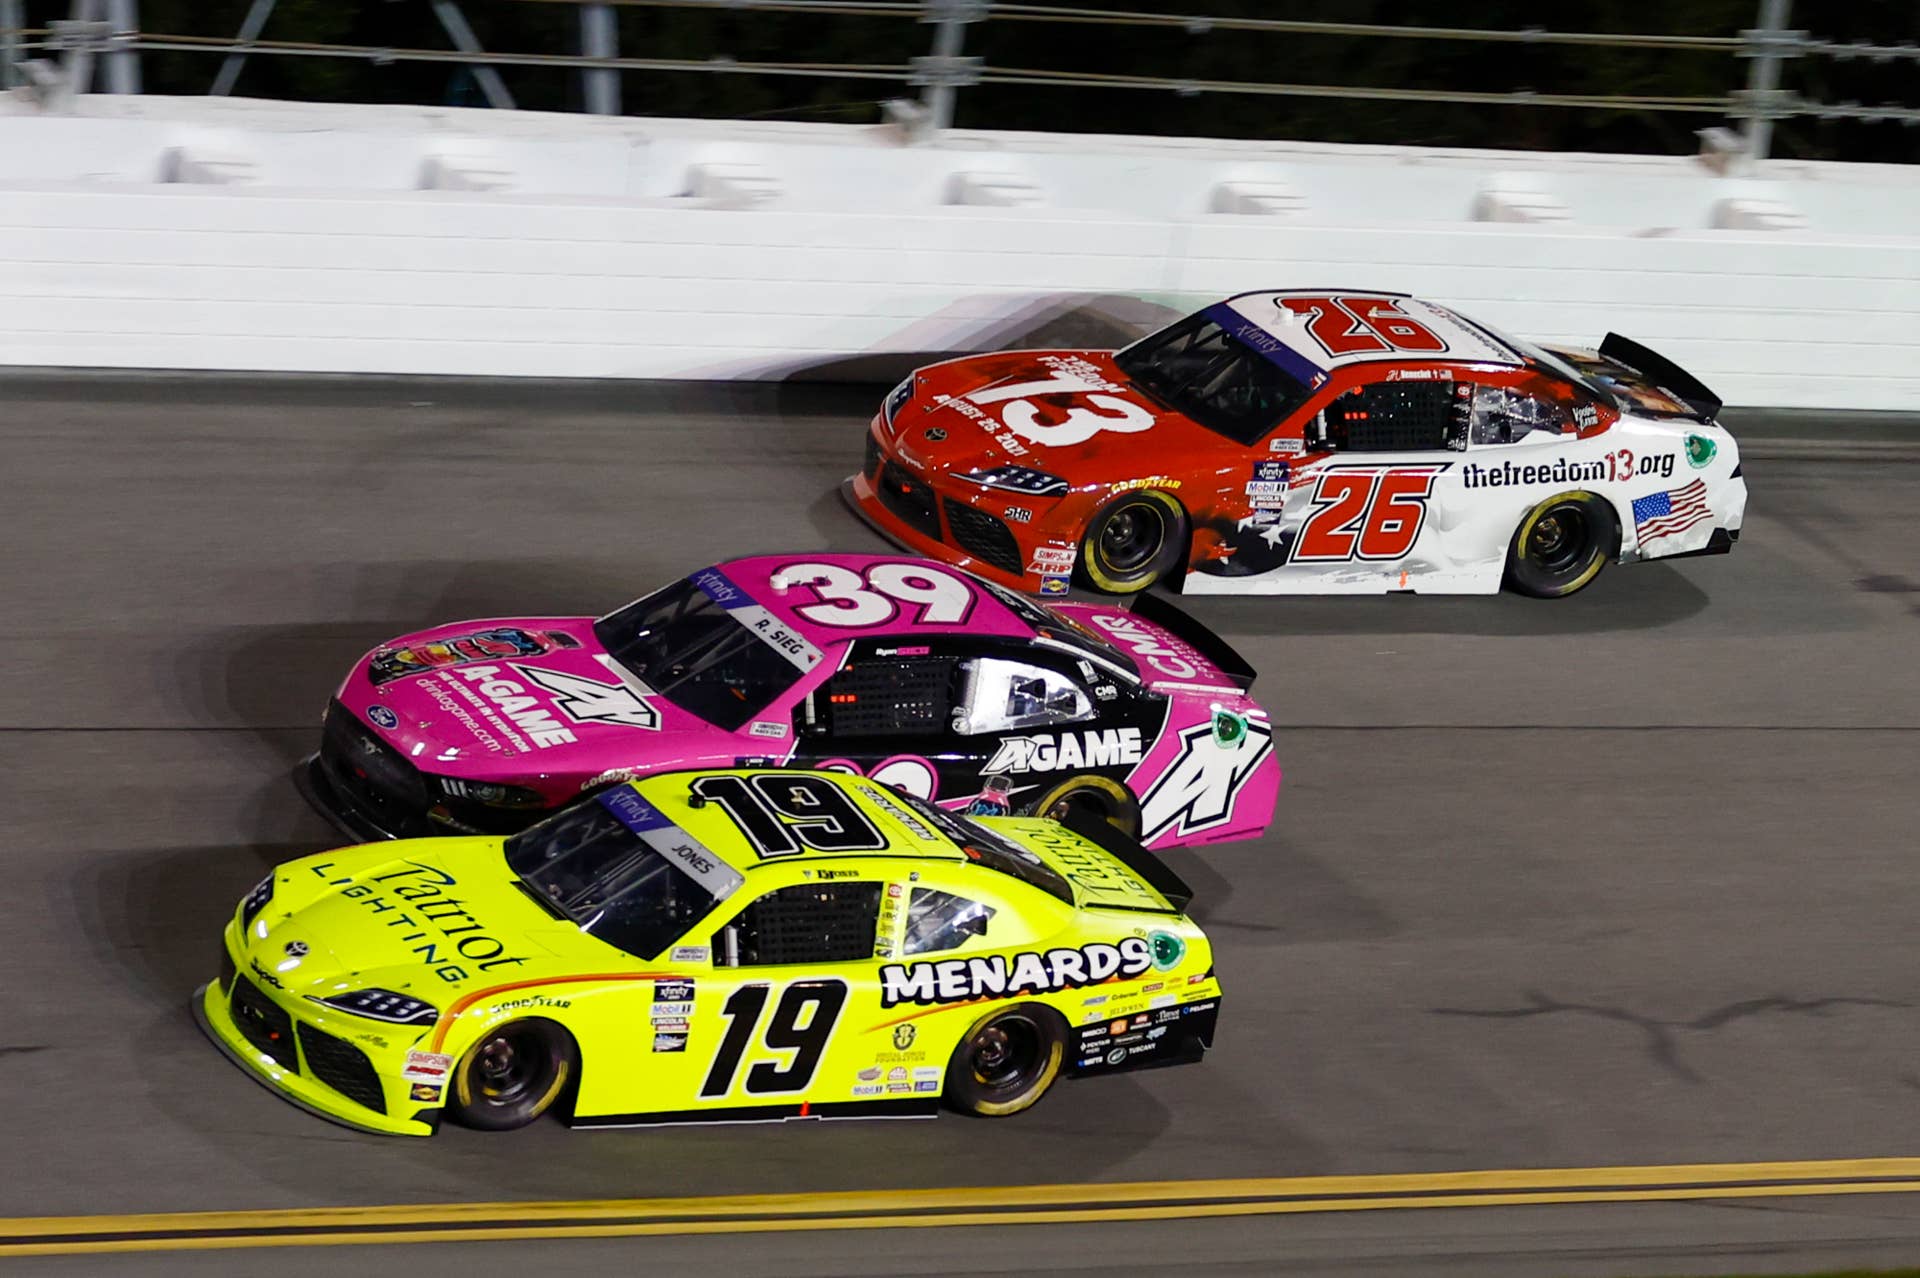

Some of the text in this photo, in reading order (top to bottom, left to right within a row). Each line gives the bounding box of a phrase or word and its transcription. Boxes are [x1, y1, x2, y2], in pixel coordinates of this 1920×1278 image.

[1236, 324, 1282, 354] xfinity
[1273, 296, 1450, 359] 26
[1036, 356, 1128, 393] FREEDOM
[965, 370, 1156, 447] 13
[994, 430, 1029, 457] 2021
[1258, 466, 1284, 479] xfinity
[1462, 448, 1676, 489] thefreedom13.org
[1248, 483, 1275, 493] Mobil
[1290, 463, 1454, 564] 26
[1026, 562, 1072, 574] ARP
[696, 572, 738, 602] xfinity
[770, 561, 977, 627] 39
[754, 618, 804, 655] R. SIEG
[416, 677, 502, 753] drinkagame.com
[453, 665, 578, 749] A-GAME
[608, 790, 654, 824] xfinity
[688, 774, 888, 861] 19
[671, 844, 716, 875] JONES
[311, 863, 469, 983] LIGHTING
[368, 858, 532, 973] Patriot
[879, 936, 1153, 1007] MENARDS
[653, 1004, 680, 1013] Mobil
[660, 987, 689, 998] xfinity
[699, 980, 850, 1100] 19
[408, 1052, 451, 1069] SIMPSON
